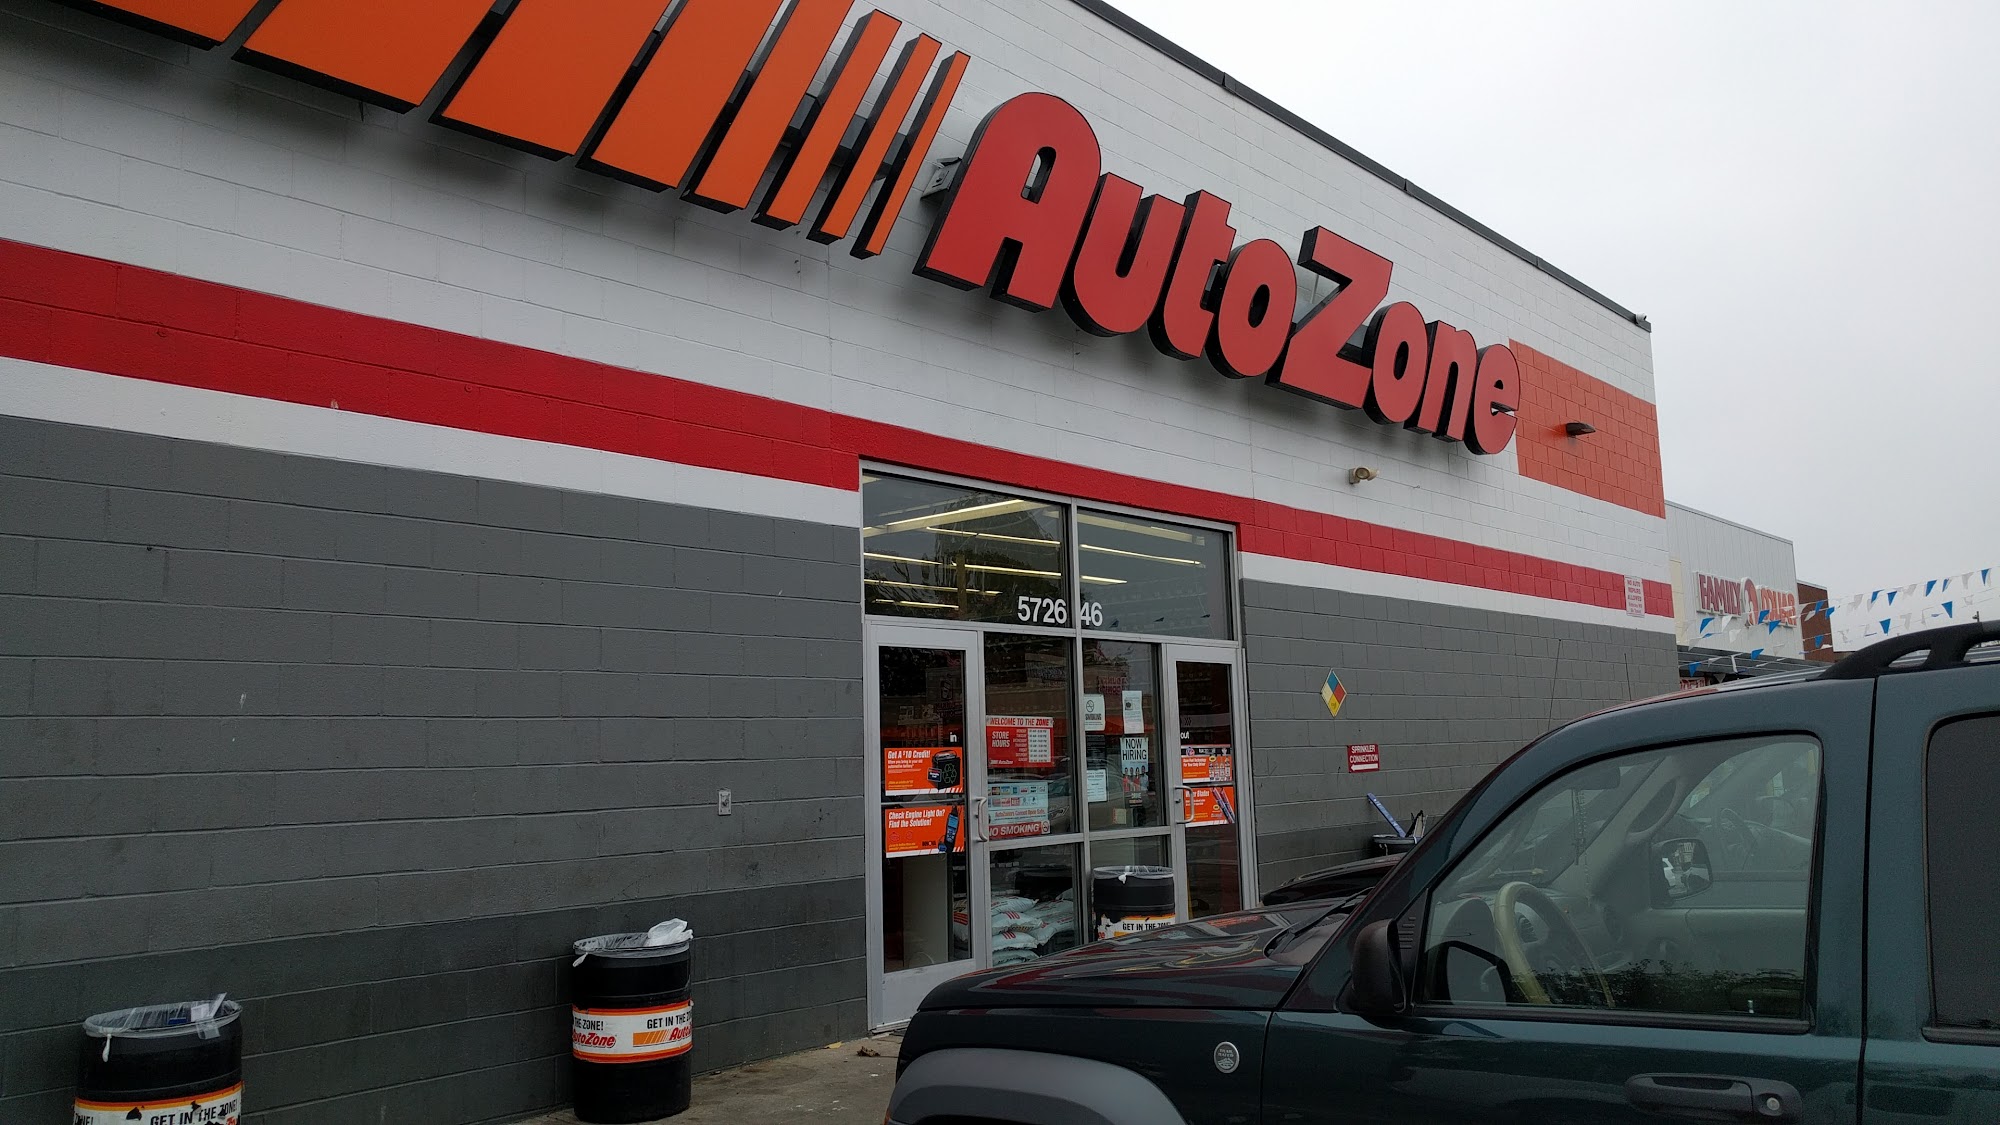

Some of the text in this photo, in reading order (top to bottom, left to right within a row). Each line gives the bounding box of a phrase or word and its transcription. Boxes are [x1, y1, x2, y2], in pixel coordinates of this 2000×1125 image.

[914, 92, 1520, 455] AutoZone
[1699, 574, 1741, 615] FAMILY
[1018, 596, 1103, 627] 5726 46
[991, 717, 1049, 726] WELCOME TO THE ZONE
[950, 732, 957, 742] in
[992, 731, 1010, 740] STORE
[1180, 731, 1190, 739] out
[991, 739, 1010, 748] HOURS
[1126, 738, 1143, 749] NOW
[1351, 744, 1376, 754] SPRINKLER
[888, 751, 898, 760] Get
[898, 751, 902, 759] A
[912, 749, 931, 759] Credit!
[1122, 749, 1147, 761] HIRING
[1349, 754, 1379, 763] CONNECTION
[888, 809, 946, 820] Check Engine Light On?
[888, 818, 932, 829] Find the Solution!
[1000, 823, 1040, 836] SMOKING
[1122, 922, 1135, 931] GET
[1136, 923, 1144, 931] IN
[1145, 922, 1156, 931] THE
[582, 1019, 604, 1031] ZONE!
[647, 1017, 663, 1030] GET
[665, 1016, 674, 1027] IN
[675, 1012, 686, 1025] THE
[150, 1113, 176, 1125] GET
[179, 1111, 194, 1125] IN
[198, 1106, 217, 1122] THE
